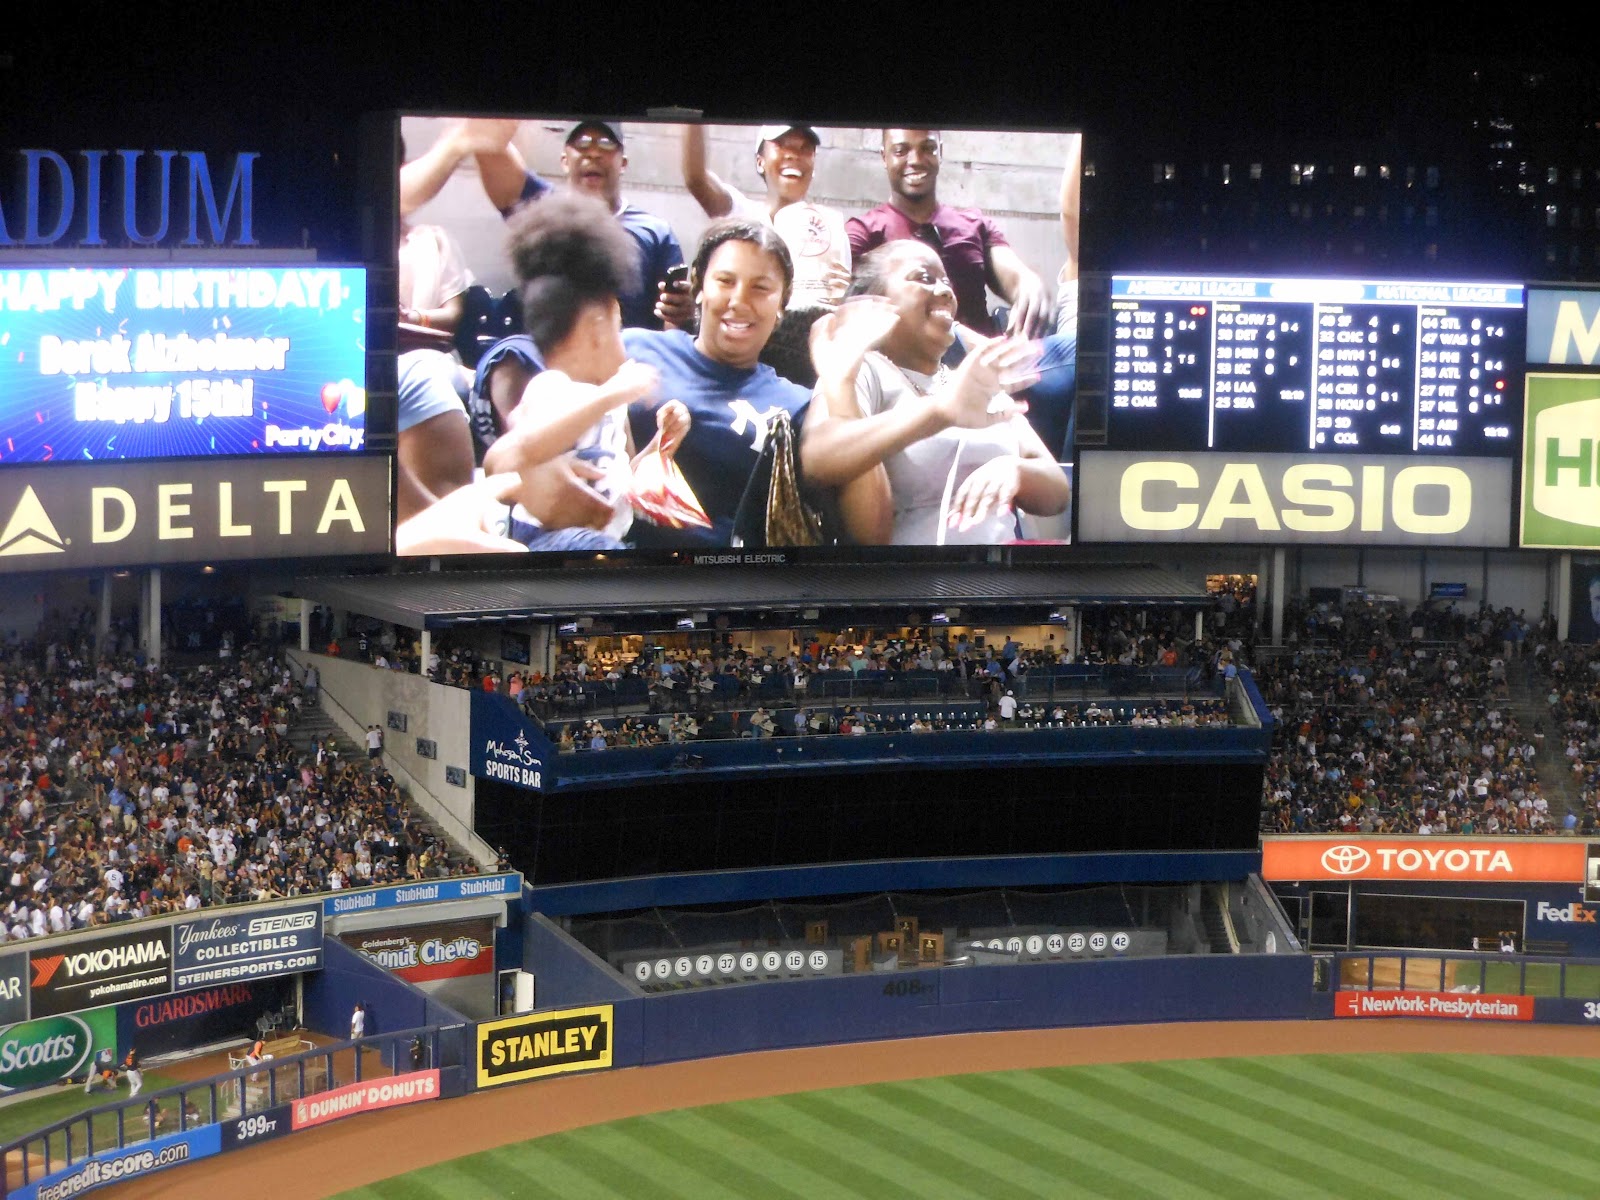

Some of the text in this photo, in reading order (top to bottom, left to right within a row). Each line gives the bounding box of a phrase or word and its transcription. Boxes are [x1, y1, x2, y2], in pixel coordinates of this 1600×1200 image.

[0, 149, 260, 246] DIUM
[0, 270, 342, 312] HAPPY BIRTHDAY!
[1127, 281, 1257, 297] AMERICAN LEAGUE
[1376, 285, 1507, 303] NATIONAL LEAGUE
[1133, 311, 1156, 323] TEX
[1165, 312, 1173, 323] 3
[1218, 313, 1233, 324] 44
[1267, 314, 1275, 325] 3
[1338, 315, 1352, 327] SF
[1369, 316, 1378, 327] 4
[1440, 317, 1460, 329] STL
[1188, 321, 1196, 330] 4
[1290, 323, 1298, 332] 4
[1133, 327, 1153, 339] CLE
[1164, 328, 1173, 339] 0
[1235, 329, 1258, 340] DET
[1266, 330, 1275, 341] 4
[1318, 330, 1335, 344] 32
[1337, 331, 1363, 343] CHC
[1495, 328, 1503, 336] 4
[1440, 333, 1468, 345] WAS
[1165, 346, 1171, 357] 1
[1369, 350, 1376, 361] 1
[1471, 352, 1479, 363] 1
[1132, 361, 1156, 373] TOR
[1163, 362, 1172, 373] 2
[1234, 363, 1251, 374] KC
[1317, 363, 1334, 376] 24
[1494, 362, 1502, 370] 4
[1438, 367, 1460, 379] ATL
[1132, 380, 1156, 391] BOS
[1216, 381, 1256, 393] 24 LAA
[1317, 383, 1333, 394] 44
[1420, 385, 1436, 396] 27
[1114, 396, 1157, 407] 32 OAK
[1233, 397, 1254, 408] SEA
[1391, 392, 1398, 401] 1
[1494, 395, 1500, 404] 1
[75, 382, 173, 424] Happy
[1335, 399, 1364, 410] HOU
[1334, 432, 1358, 444] COL
[1418, 434, 1451, 446] 44 LA
[1119, 461, 1472, 534] CASIO
[91, 479, 366, 544] DELTA
[694, 554, 786, 565] MITSUBISHI ELECTRIC
[486, 740, 542, 766] Mohegan Sun
[486, 760, 541, 789] SPORTS BAR
[1376, 849, 1513, 872] TOYOTA
[334, 877, 505, 912] StubHub! StubHub! StubHub!
[1536, 901, 1597, 923] FedEx
[179, 915, 315, 956] Yankees STEINER
[196, 935, 298, 961] COLLECTIBLES
[362, 937, 409, 948] Goldenberg's
[421, 939, 479, 963] Chews
[65, 940, 166, 977] YOKOHAMA
[178, 956, 317, 986] STEINERSPORTS.COM
[90, 975, 167, 998] yokohamatire.com
[135, 984, 252, 1028] GUARDSMARK
[491, 1025, 598, 1066] STANLEY
[0, 1034, 76, 1073] Scotts
[310, 1077, 434, 1119] DUNKIN' DONUTS
[37, 1142, 188, 1200] freecreditscore.com
